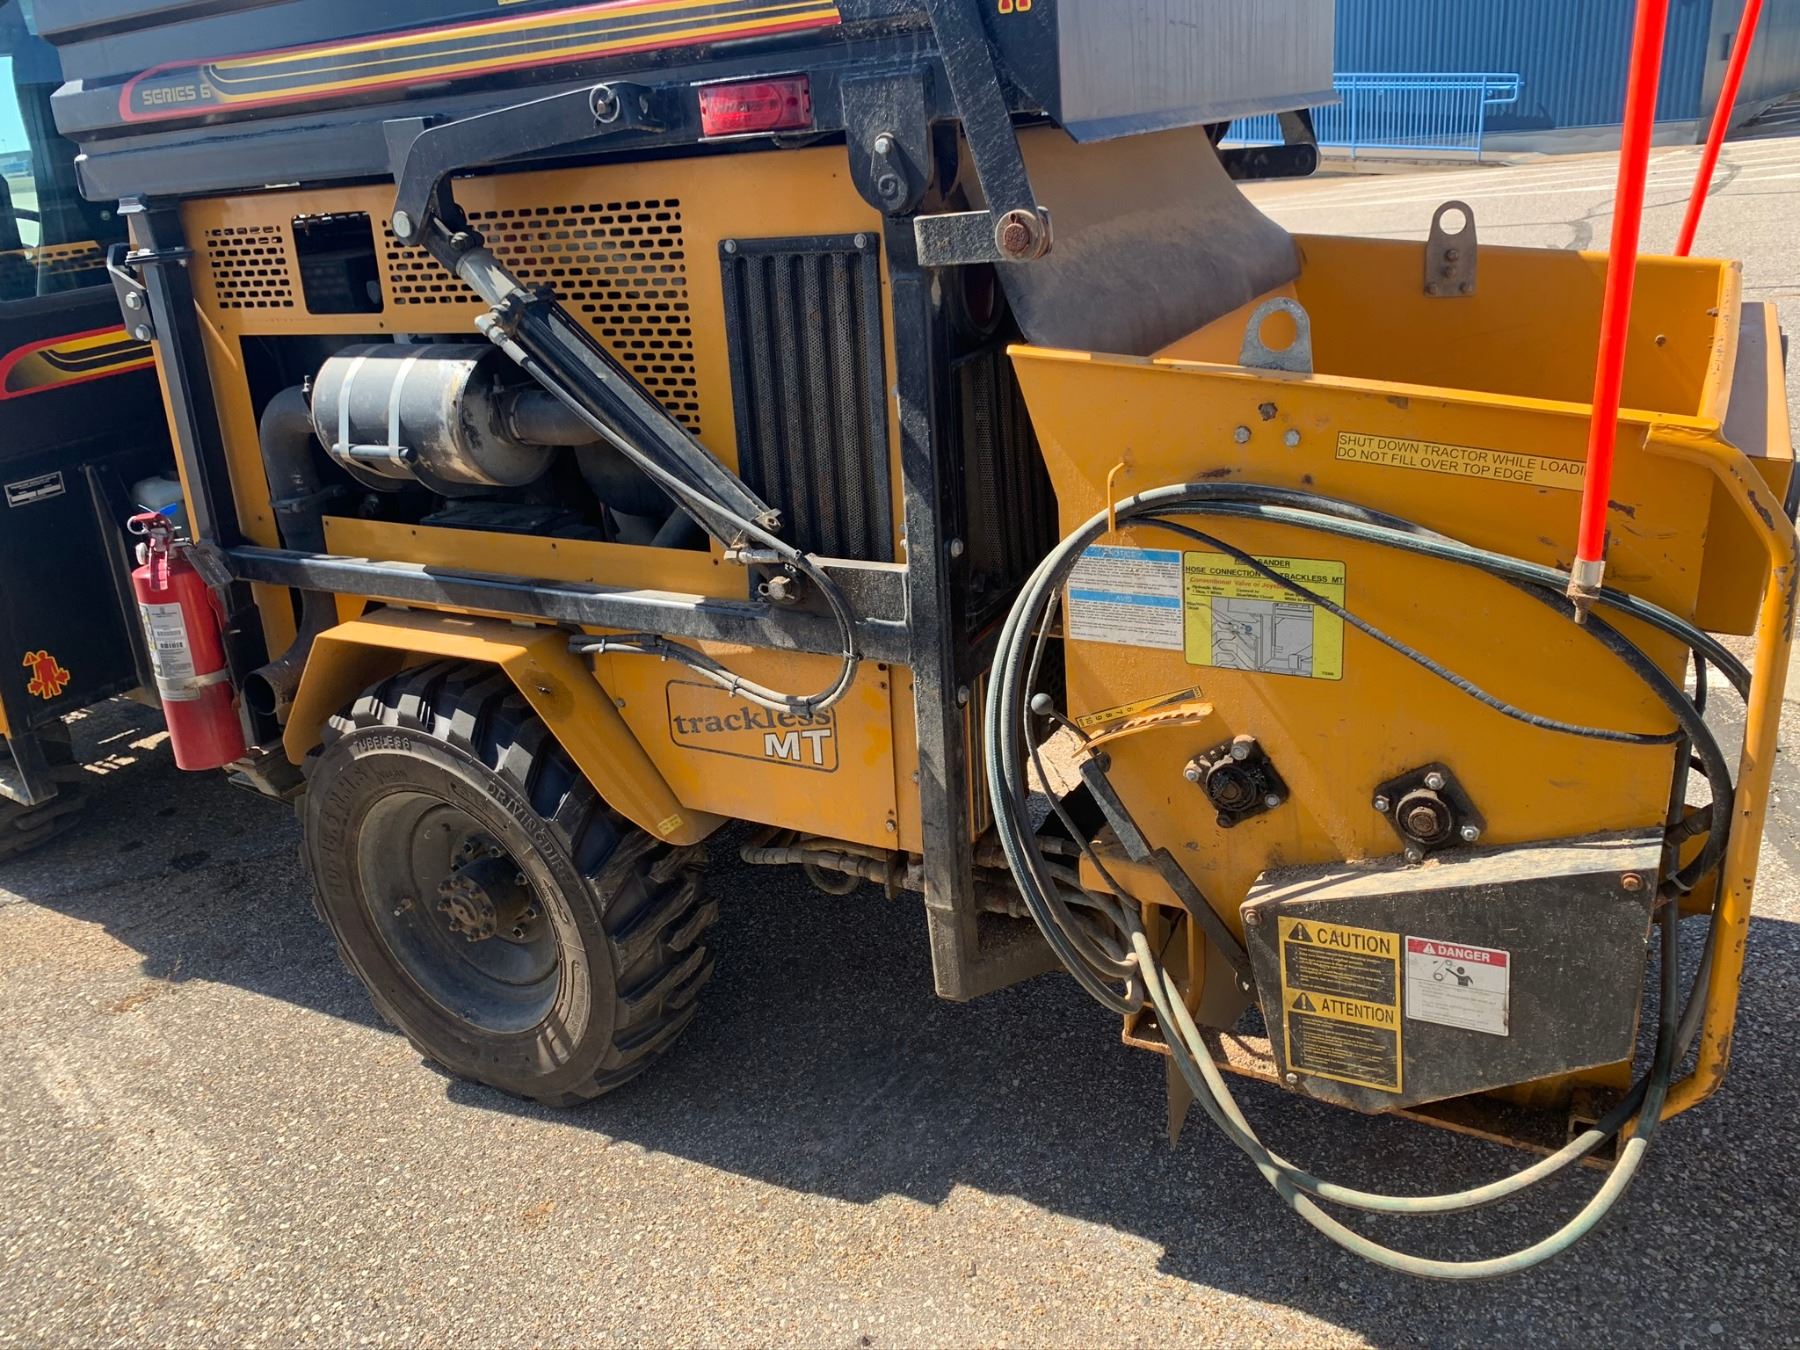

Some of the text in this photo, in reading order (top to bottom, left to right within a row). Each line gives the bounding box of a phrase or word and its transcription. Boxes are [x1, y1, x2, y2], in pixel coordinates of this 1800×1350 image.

[142, 84, 212, 105] SERIES 6
[1337, 447, 1534, 482] DO NOT FILL OVER TOP EDGE
[1338, 434, 1588, 478] SHUT DOWN TRACTOR WHILE LOADI
[1186, 566, 1344, 584] HOSE CONNECTION TRACKLESS MT
[673, 706, 832, 735] trackless
[763, 728, 832, 765] MT
[487, 779, 548, 845] DRIVING
[1317, 928, 1391, 954] CAUTION
[1438, 945, 1491, 962] DANGER
[1322, 998, 1394, 1024] ATTENTION
